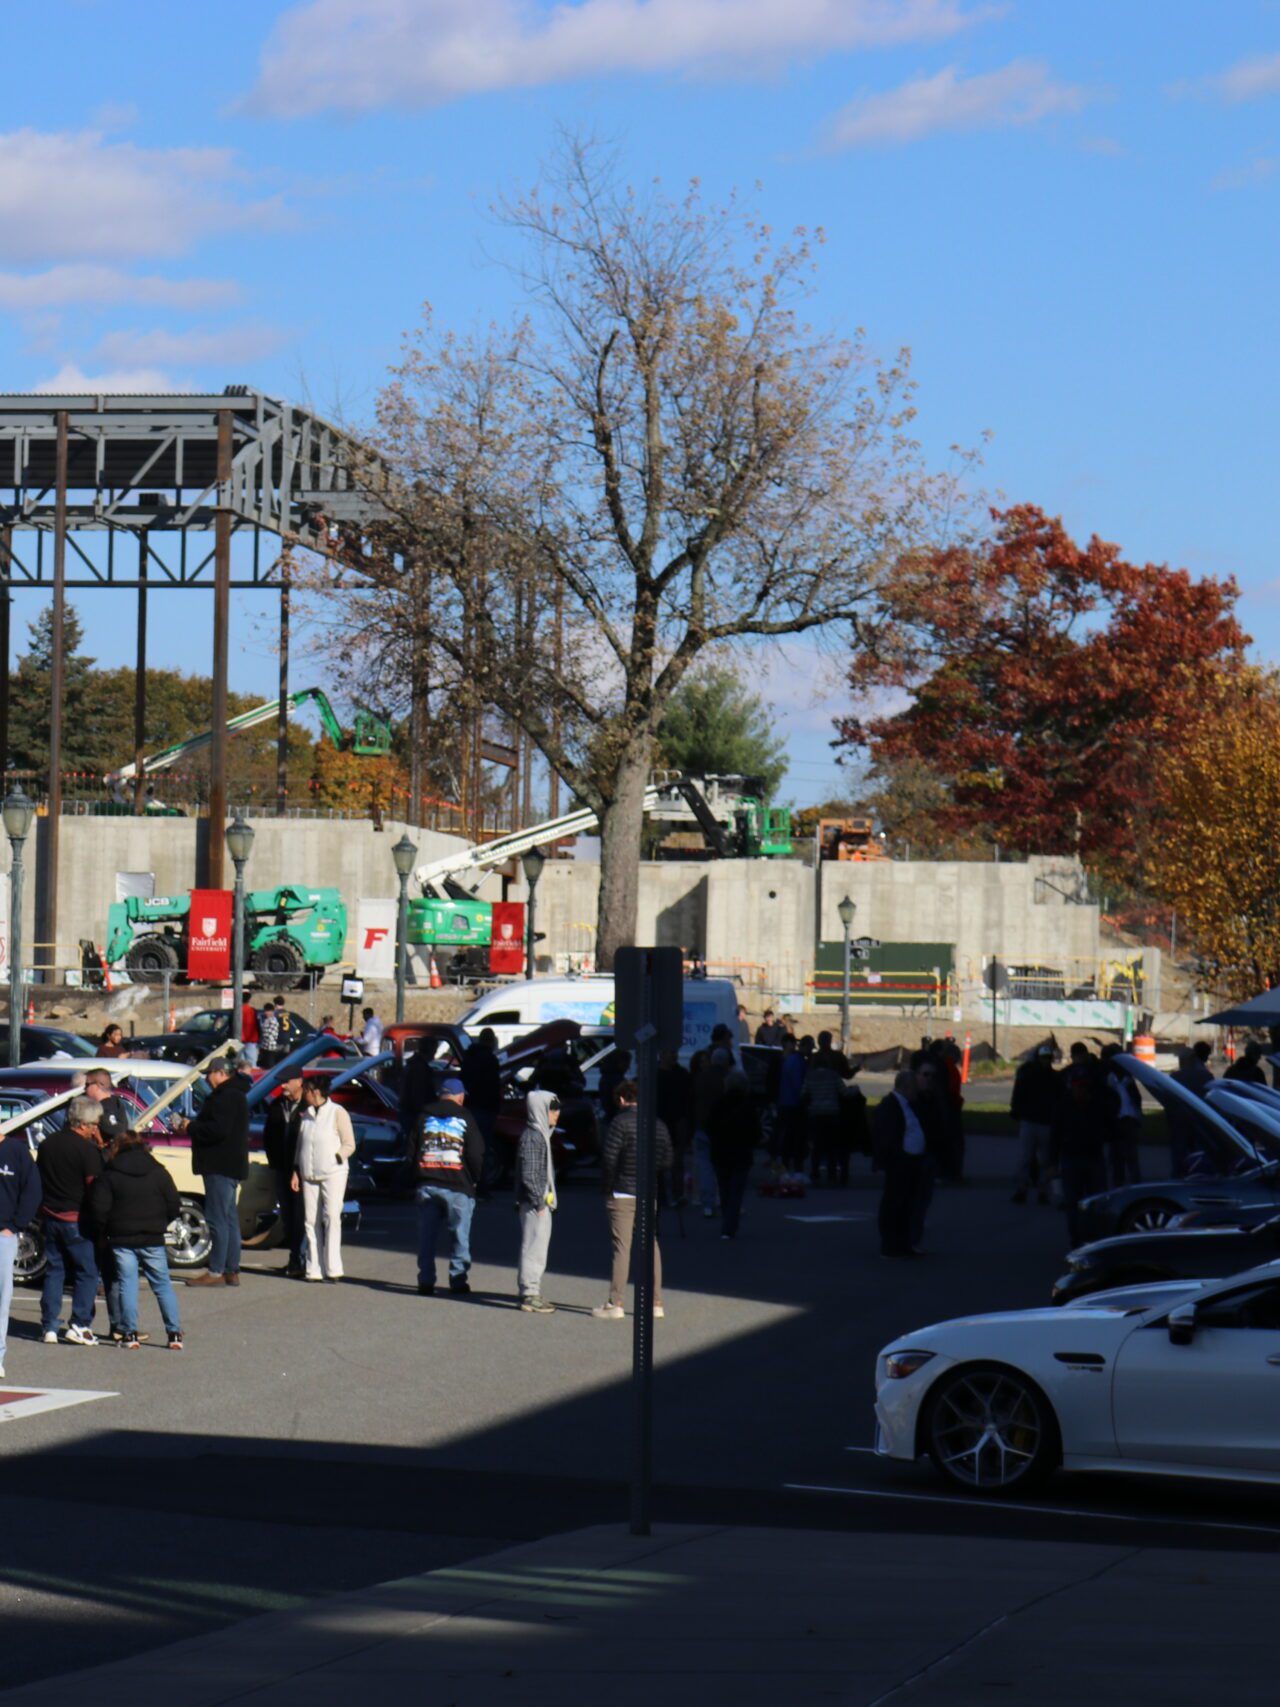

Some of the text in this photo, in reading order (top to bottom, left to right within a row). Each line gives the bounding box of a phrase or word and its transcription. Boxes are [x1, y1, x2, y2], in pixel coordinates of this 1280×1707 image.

[144, 896, 170, 906] JCB
[191, 937, 228, 946] Fairfield
[363, 928, 389, 949] F
